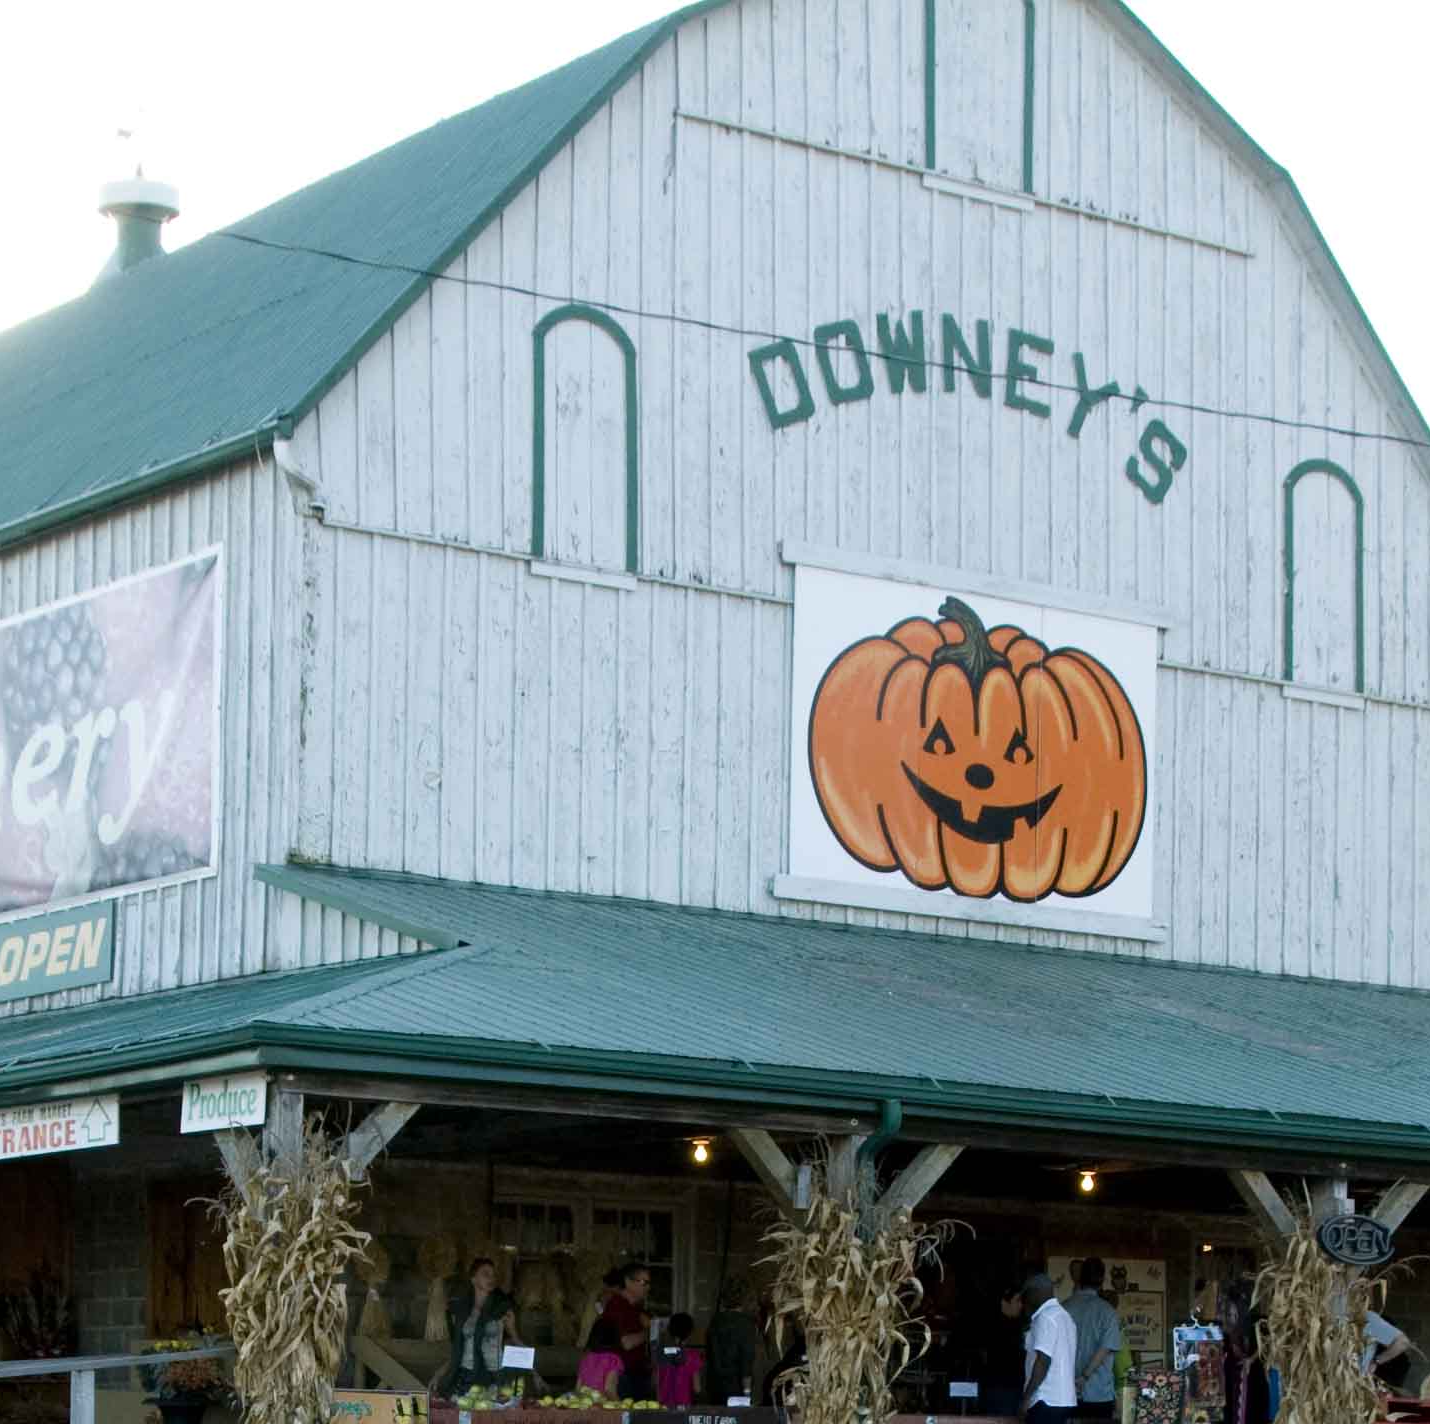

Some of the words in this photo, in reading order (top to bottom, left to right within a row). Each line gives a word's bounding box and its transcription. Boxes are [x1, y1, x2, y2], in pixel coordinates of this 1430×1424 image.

[747, 309, 1188, 504] DOWNEY'S
[187, 1079, 258, 1121] Produce
[1326, 1223, 1392, 1254] OPEN
